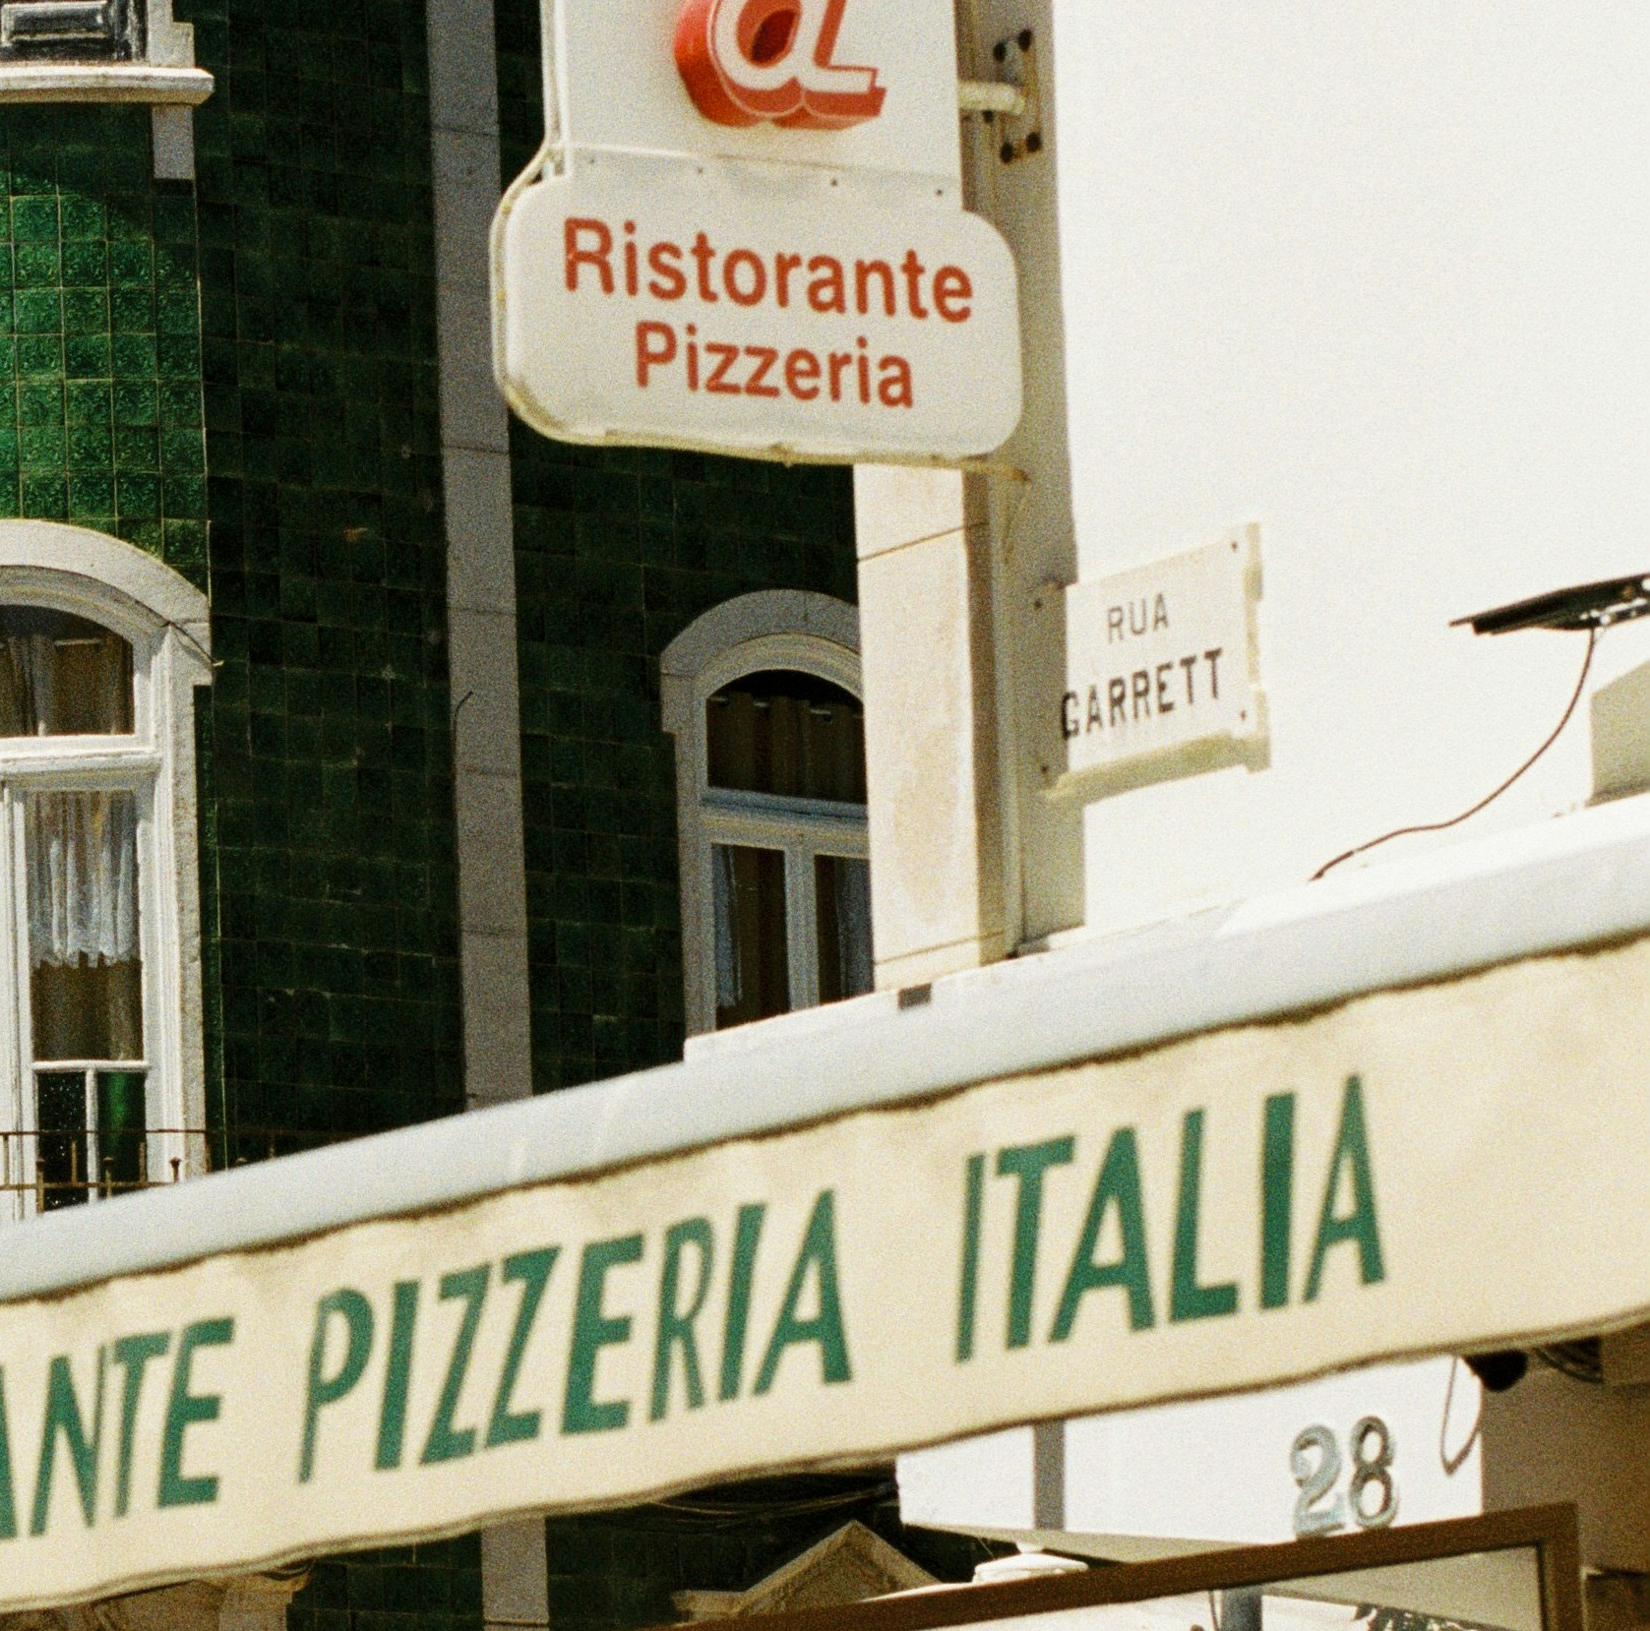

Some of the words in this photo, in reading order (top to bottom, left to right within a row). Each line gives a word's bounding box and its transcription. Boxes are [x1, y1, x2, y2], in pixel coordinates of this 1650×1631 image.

[563, 216, 974, 324] Ristorante
[634, 320, 914, 410] Pizzeria
[1107, 592, 1169, 645] RUA
[1061, 646, 1223, 741] GARRETT
[297, 1188, 853, 1486] PIZZERIA
[953, 1073, 1386, 1365] ITALIA
[1289, 1415, 1399, 1539] 28
